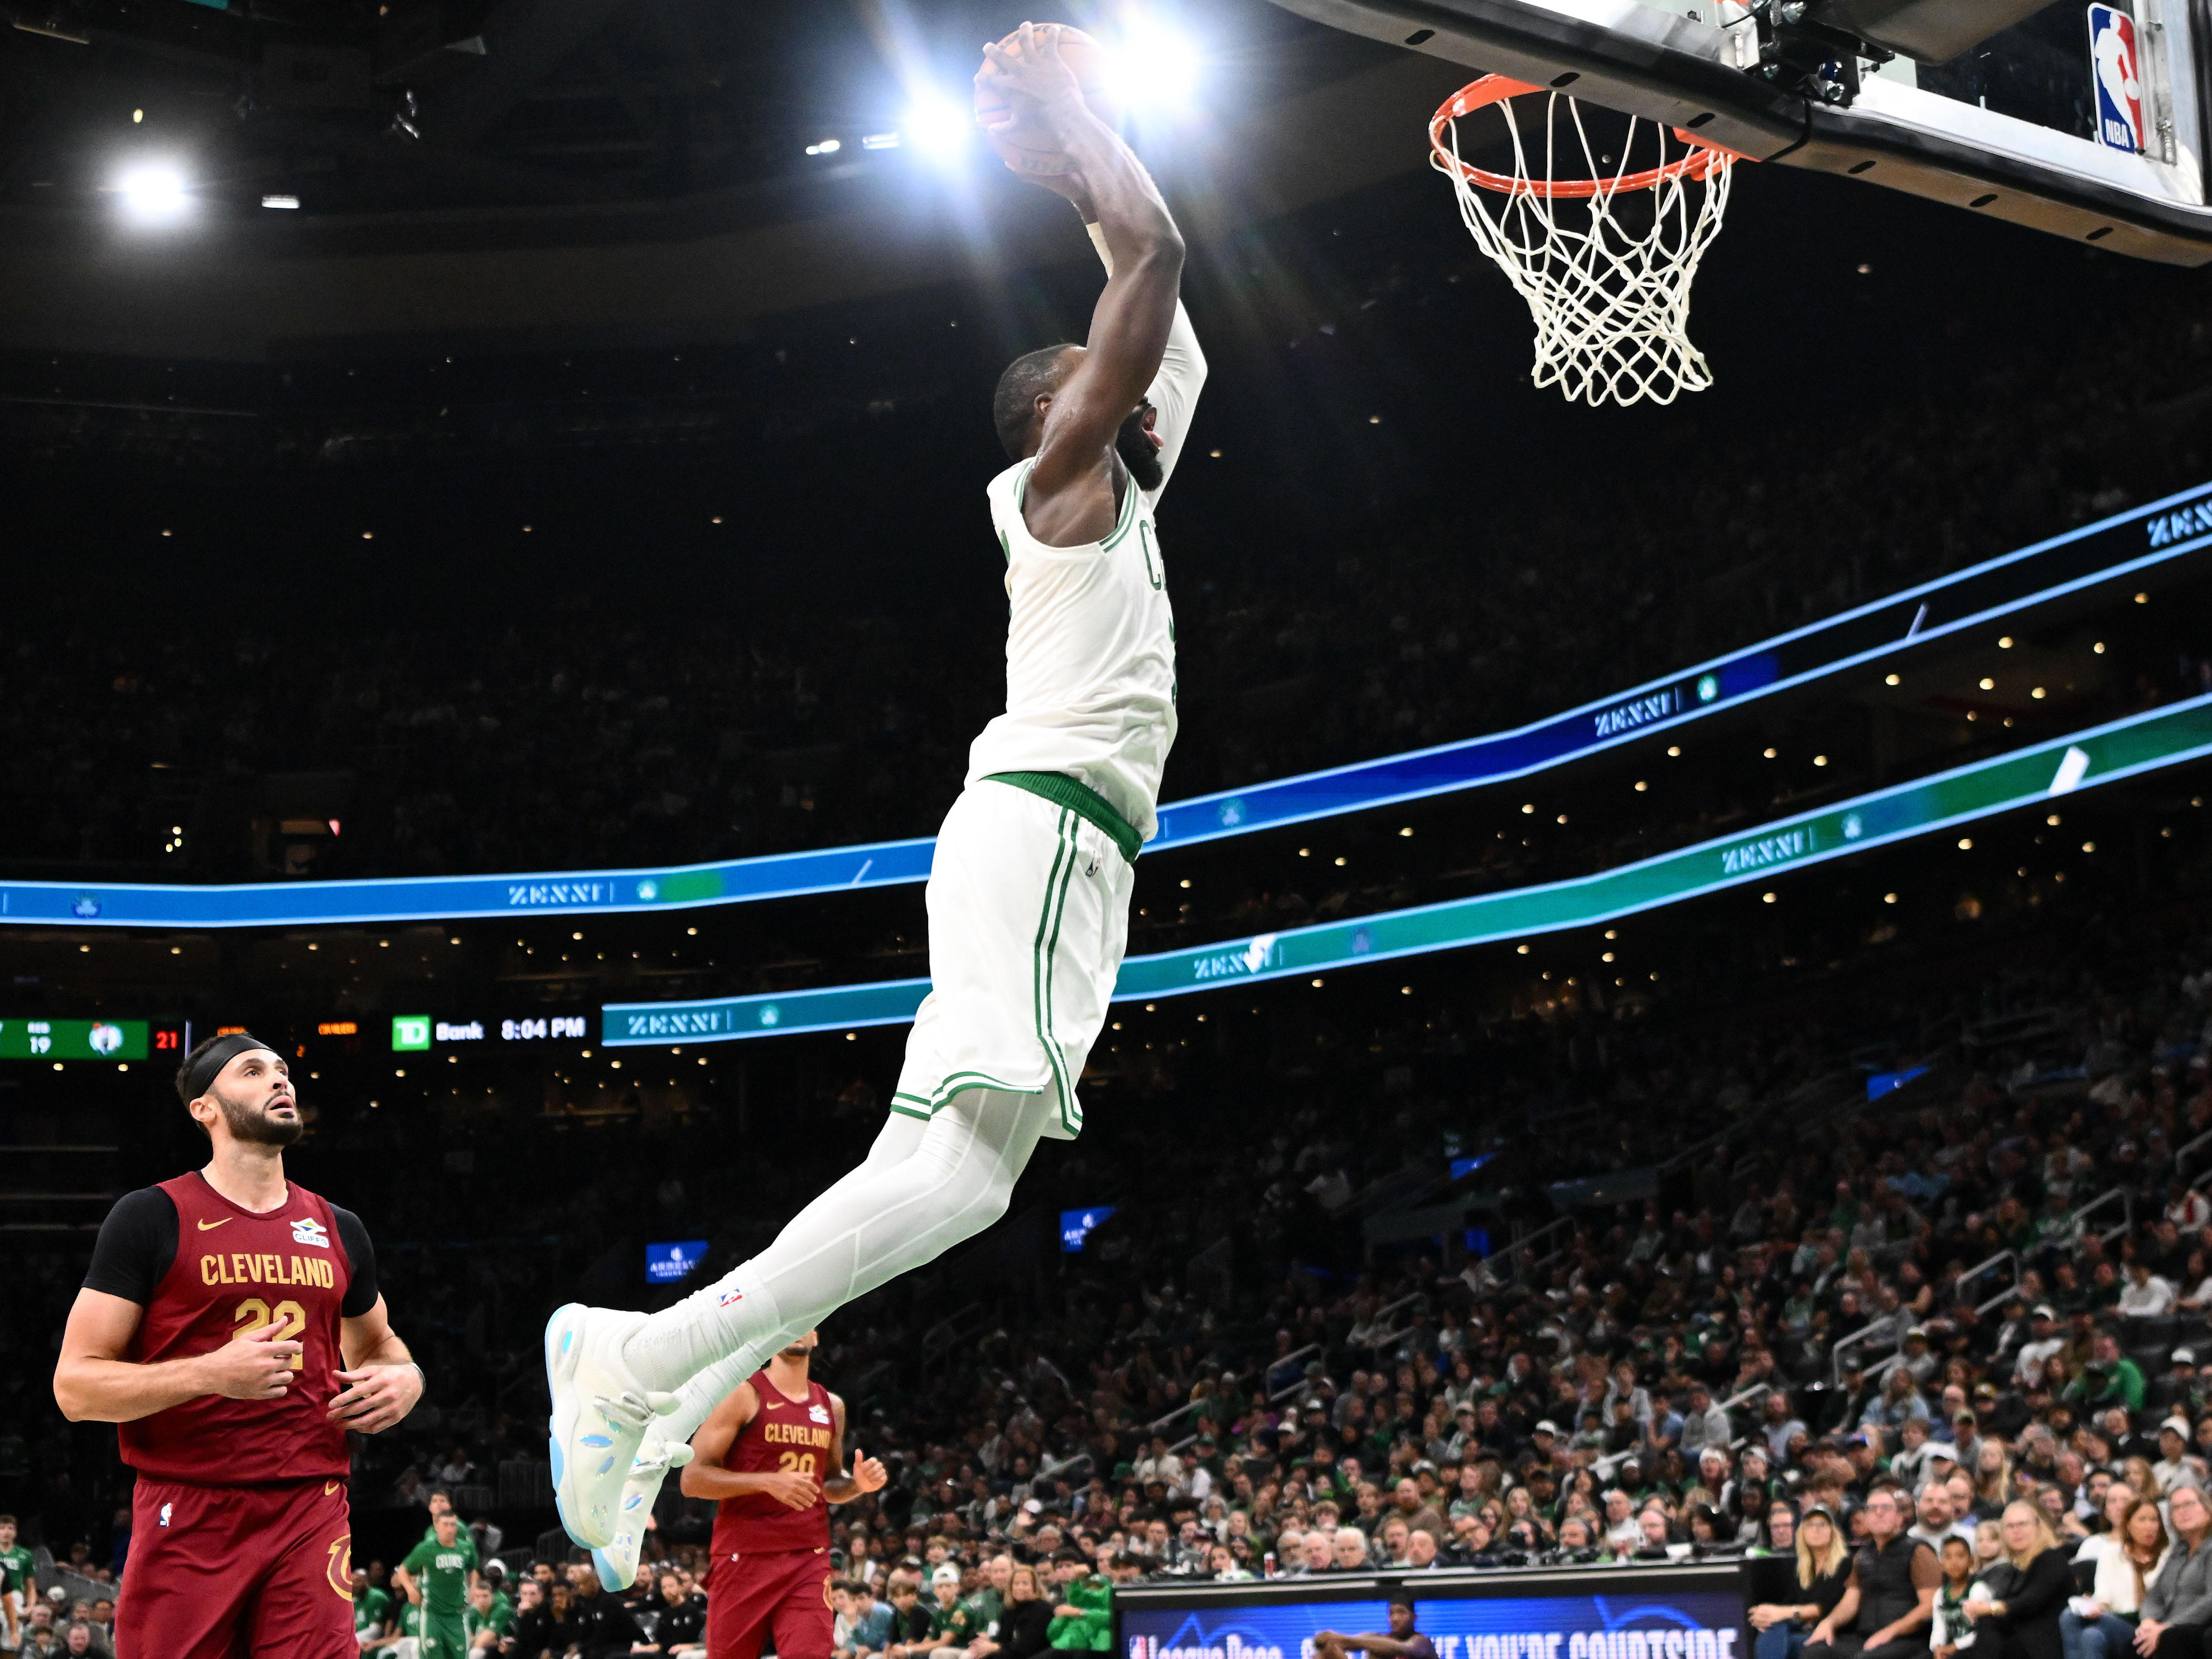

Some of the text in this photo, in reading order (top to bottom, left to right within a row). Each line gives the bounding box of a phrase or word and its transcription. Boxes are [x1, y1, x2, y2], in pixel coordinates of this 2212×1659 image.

[2104, 118, 2129, 148] NBA
[156, 1031, 177, 1049] 21
[395, 1017, 585, 1045] TD Bank 8:04 PM
[30, 1036, 51, 1054] 19
[295, 1234, 327, 1245] CLIFFS
[200, 1254, 334, 1289] CLEVELAND
[233, 1298, 306, 1370] 22
[779, 1451, 816, 1476] 20
